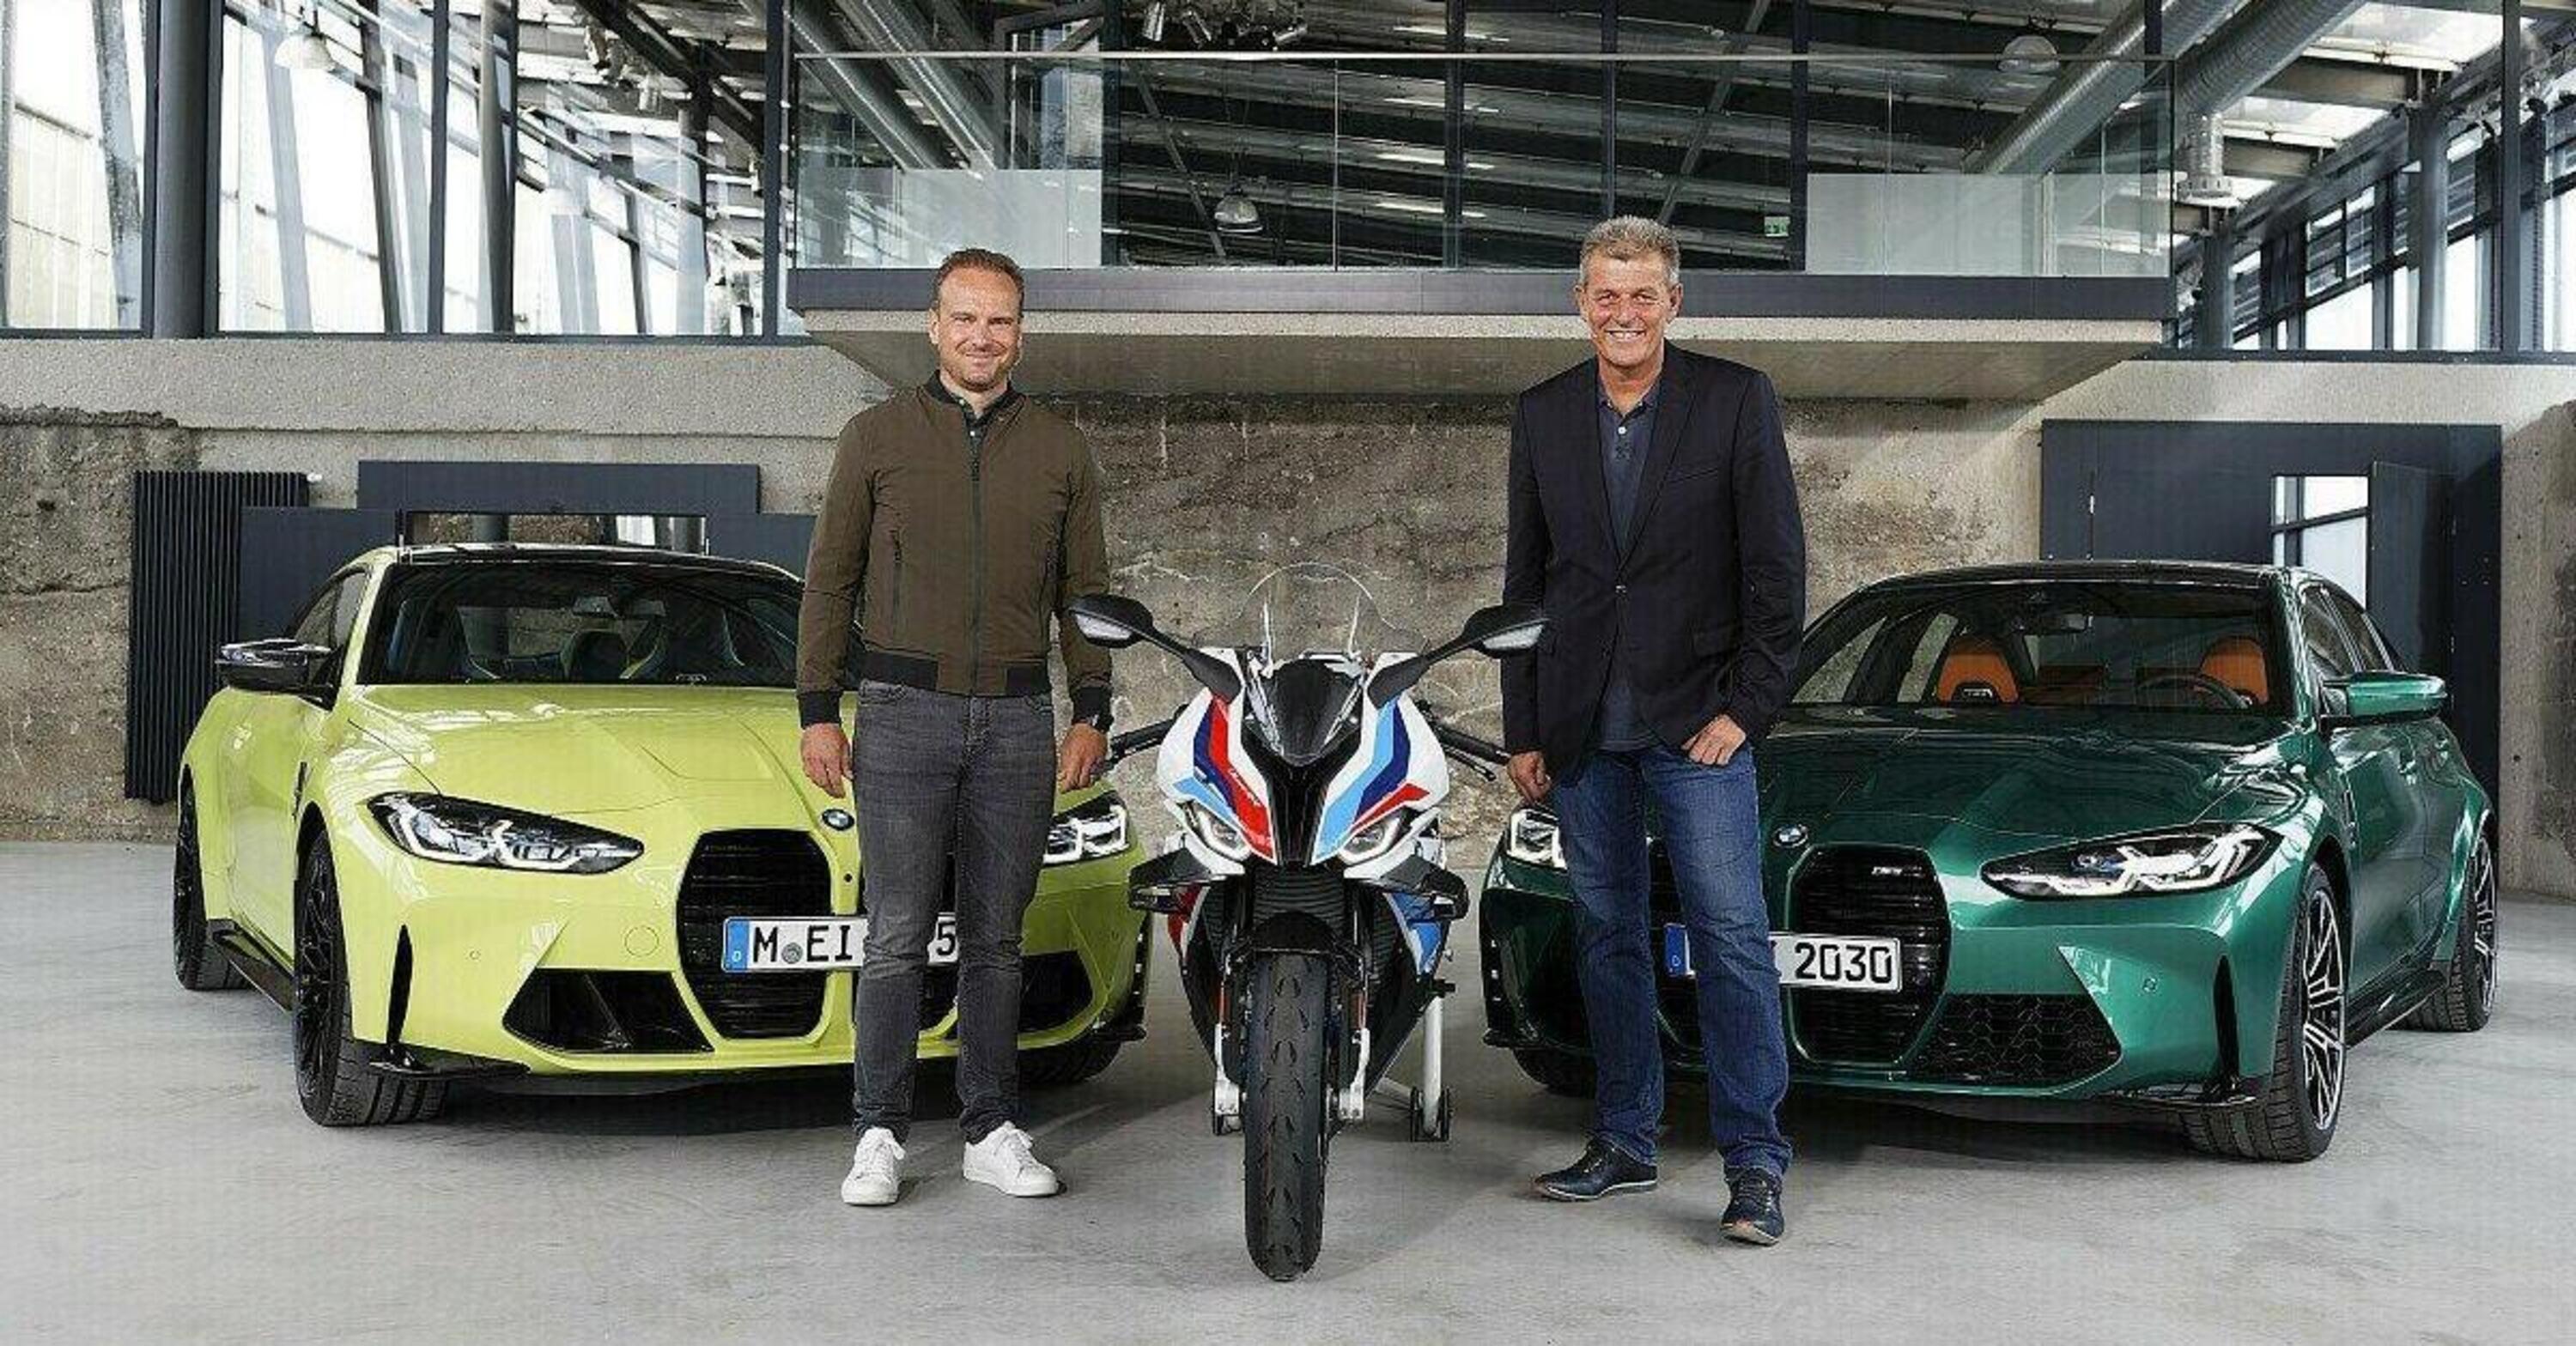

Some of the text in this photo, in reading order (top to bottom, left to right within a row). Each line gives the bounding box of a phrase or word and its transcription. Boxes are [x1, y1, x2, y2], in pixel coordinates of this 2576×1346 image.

[753, 926, 778, 962] M
[806, 925, 853, 962] EI
[1794, 942, 1893, 984] 2030
